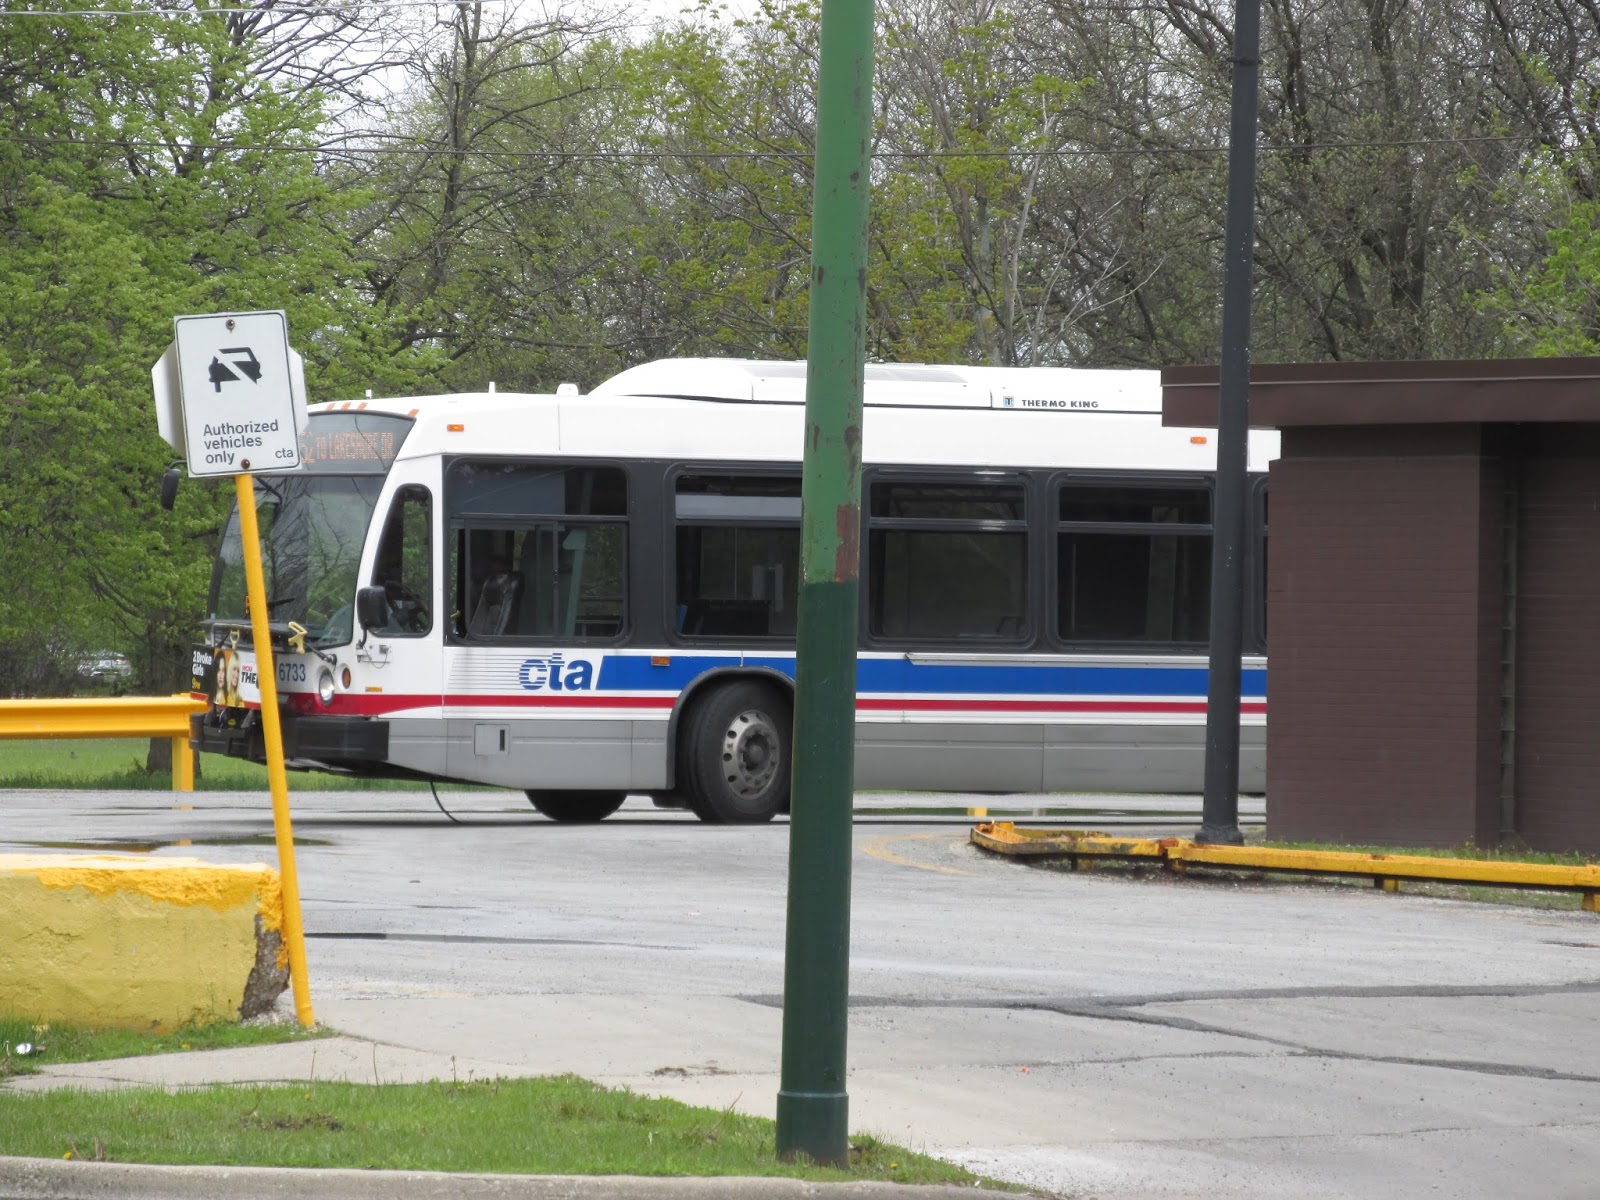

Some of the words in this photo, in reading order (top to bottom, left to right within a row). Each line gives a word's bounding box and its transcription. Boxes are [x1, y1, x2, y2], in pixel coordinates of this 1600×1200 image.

[1022, 399, 1066, 408] THERMO
[1070, 400, 1099, 408] KING
[204, 420, 278, 436] Authorized
[205, 435, 262, 450] vehicles
[206, 451, 235, 467] only
[275, 447, 294, 459] cta
[197, 652, 212, 665] Broke
[192, 663, 204, 676] Girls
[278, 663, 306, 682] 6733
[518, 652, 593, 691] cta
[241, 671, 256, 684] THE
